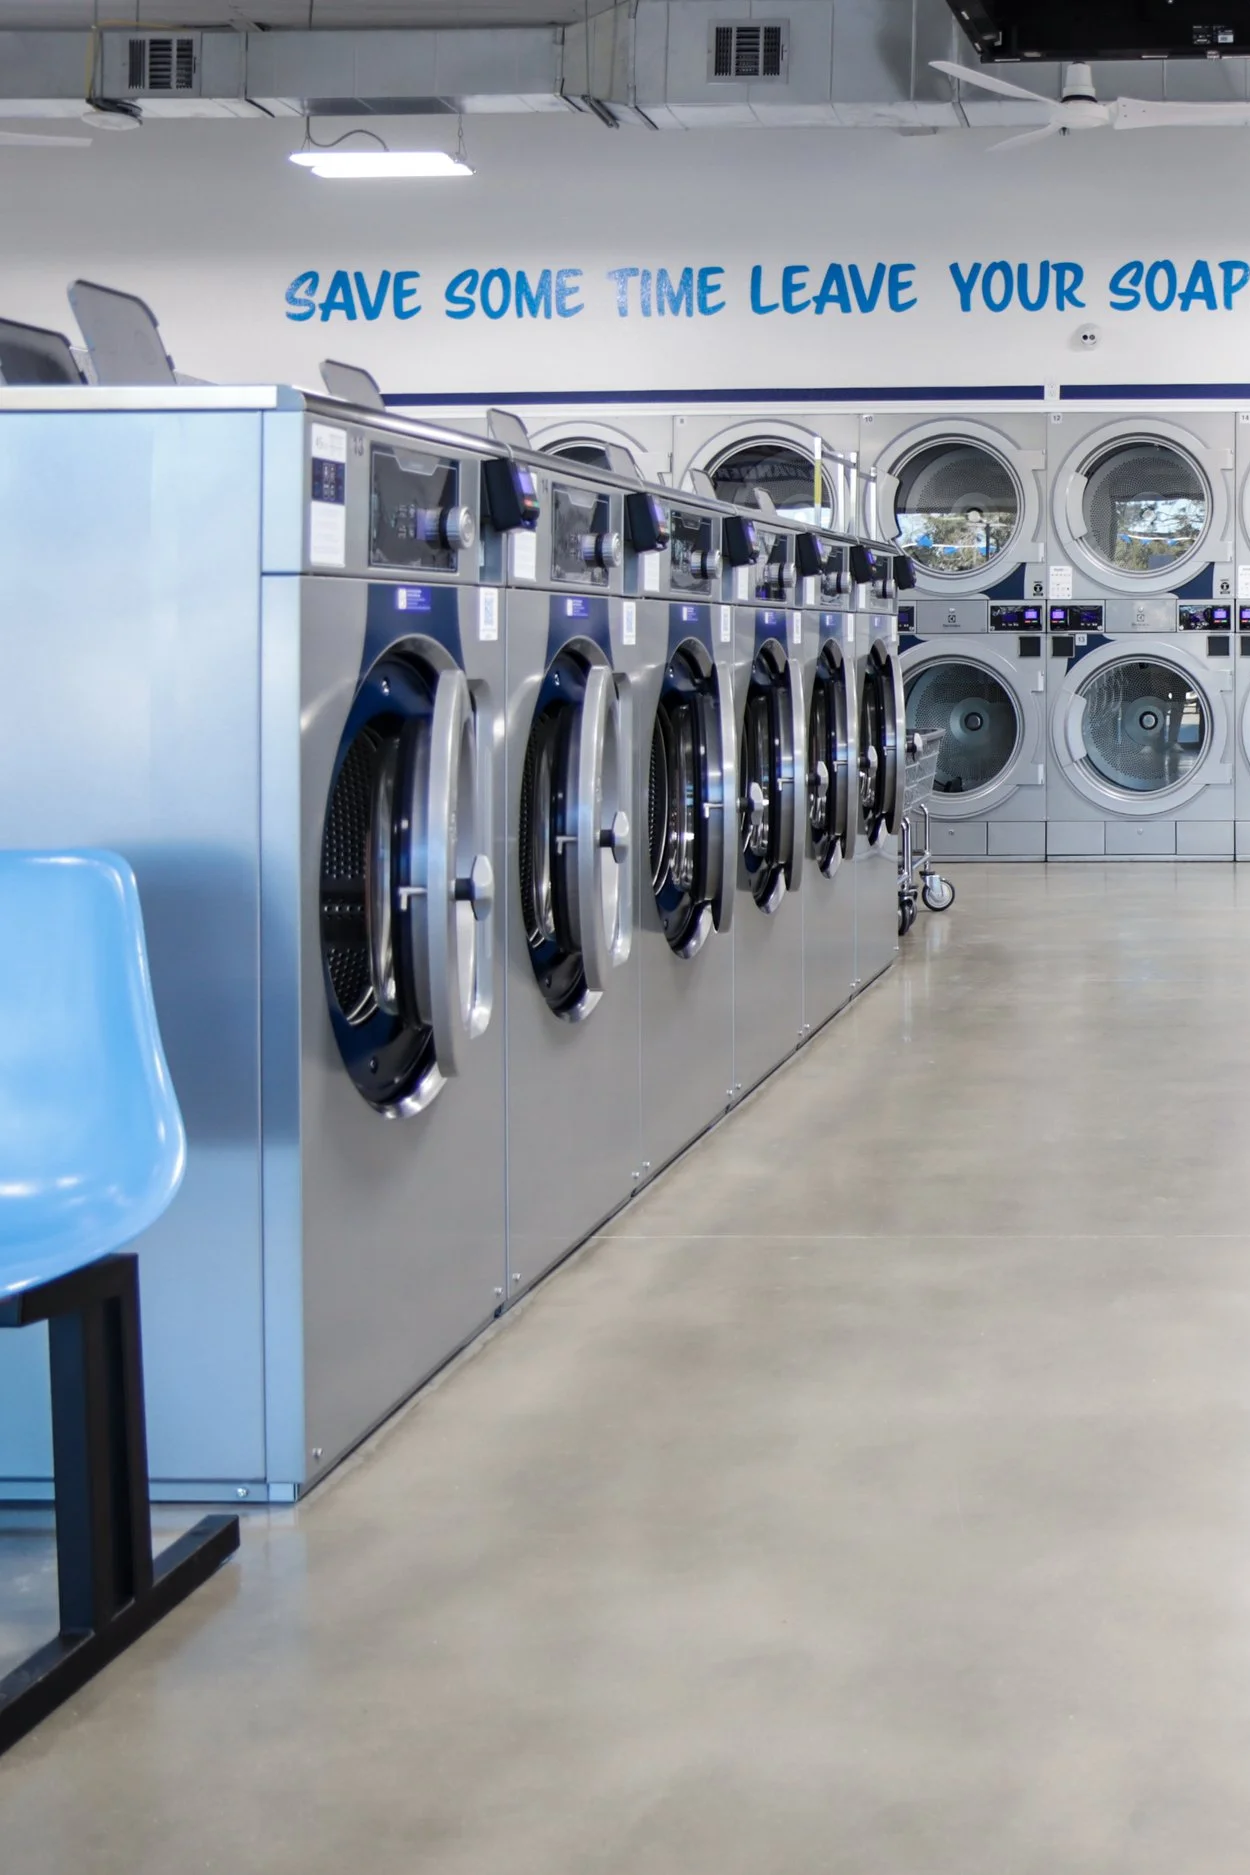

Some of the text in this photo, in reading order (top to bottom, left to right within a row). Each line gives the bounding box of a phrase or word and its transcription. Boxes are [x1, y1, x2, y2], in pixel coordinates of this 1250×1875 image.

[286, 270, 423, 324] SAVE
[445, 267, 586, 321] SOME
[607, 266, 728, 319] TIME
[750, 262, 920, 316] LEAVE
[949, 260, 1088, 314] YOUR
